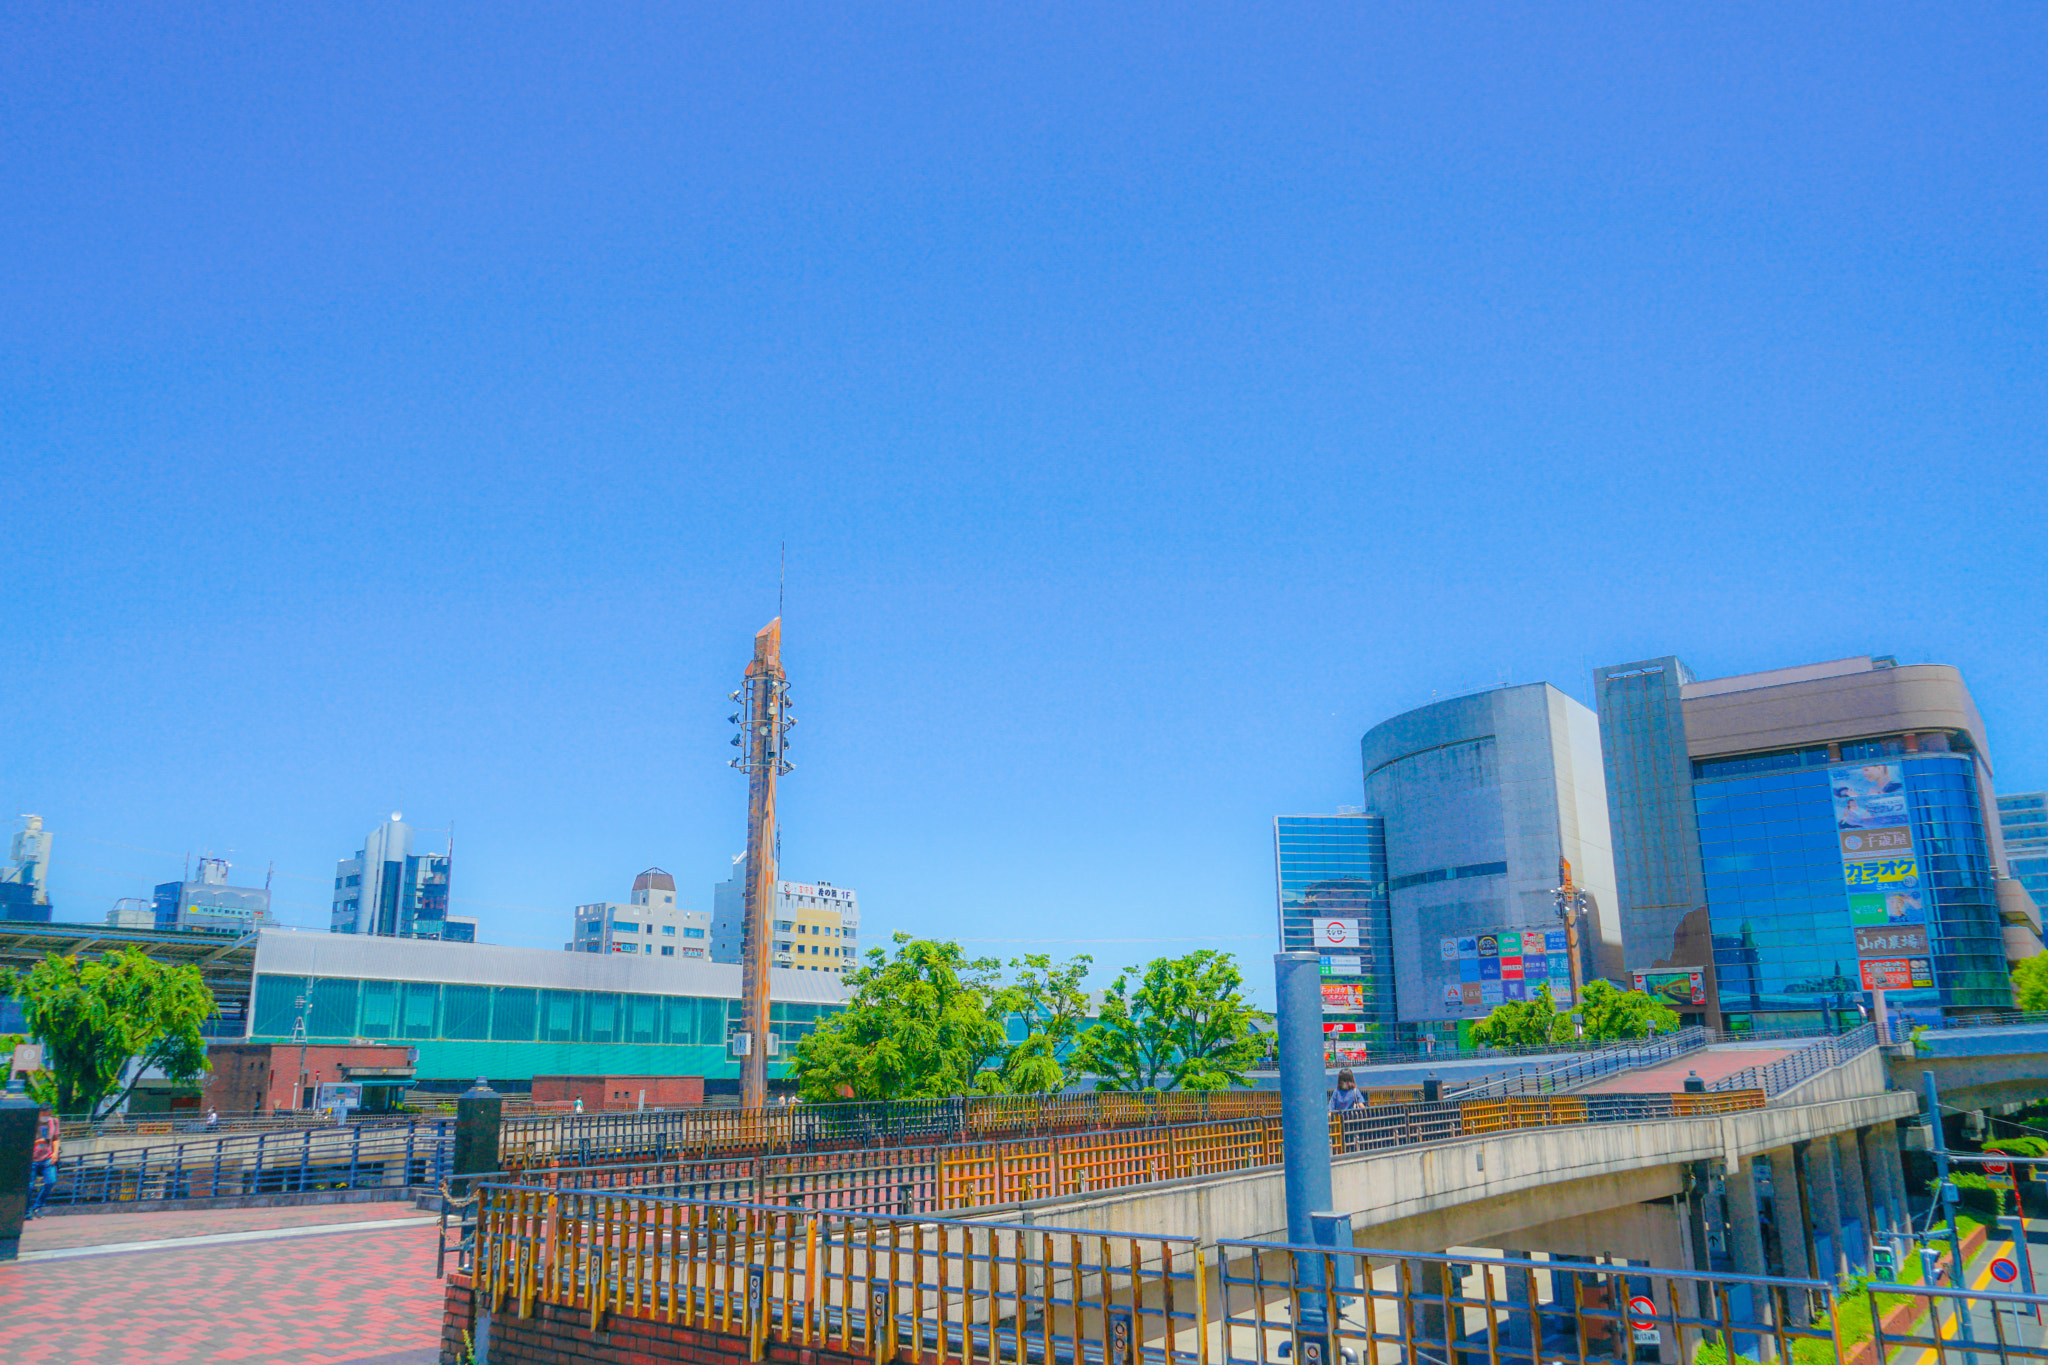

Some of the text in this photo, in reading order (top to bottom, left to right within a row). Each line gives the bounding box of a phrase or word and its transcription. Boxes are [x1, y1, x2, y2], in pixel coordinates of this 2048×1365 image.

[1865, 833, 1908, 848] 千歳屋
[1846, 860, 1915, 878] カラオケ
[1859, 933, 1918, 951] 山内農場
[1549, 957, 1569, 969] 東進
